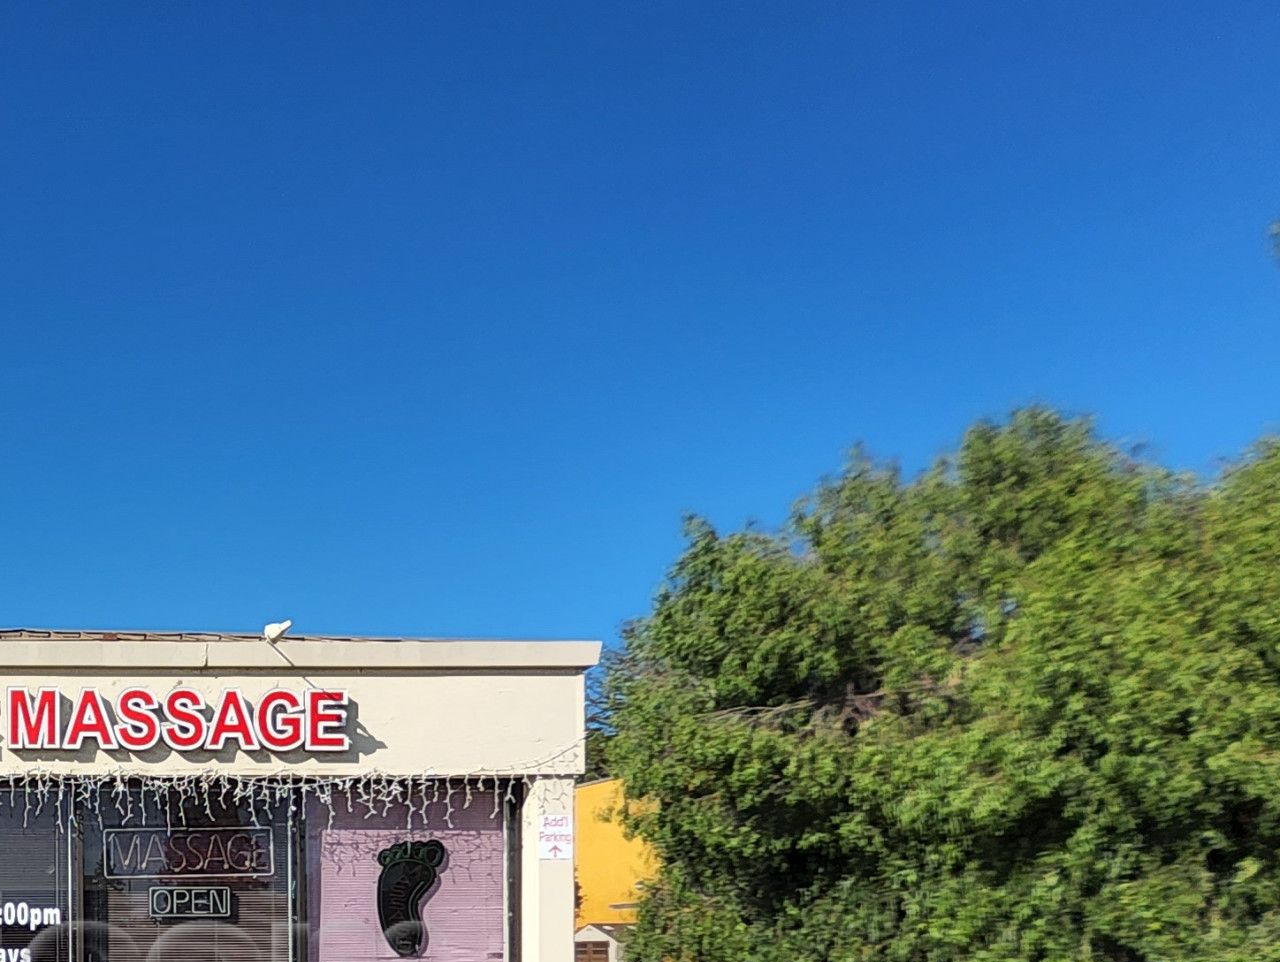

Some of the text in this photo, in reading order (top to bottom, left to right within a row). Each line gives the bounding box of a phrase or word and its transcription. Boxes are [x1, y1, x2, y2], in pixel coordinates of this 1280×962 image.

[6, 687, 350, 751] MASSAGE
[108, 832, 269, 872] MASSAGE
[539, 831, 571, 845] Parking
[153, 889, 227, 914] OPEN
